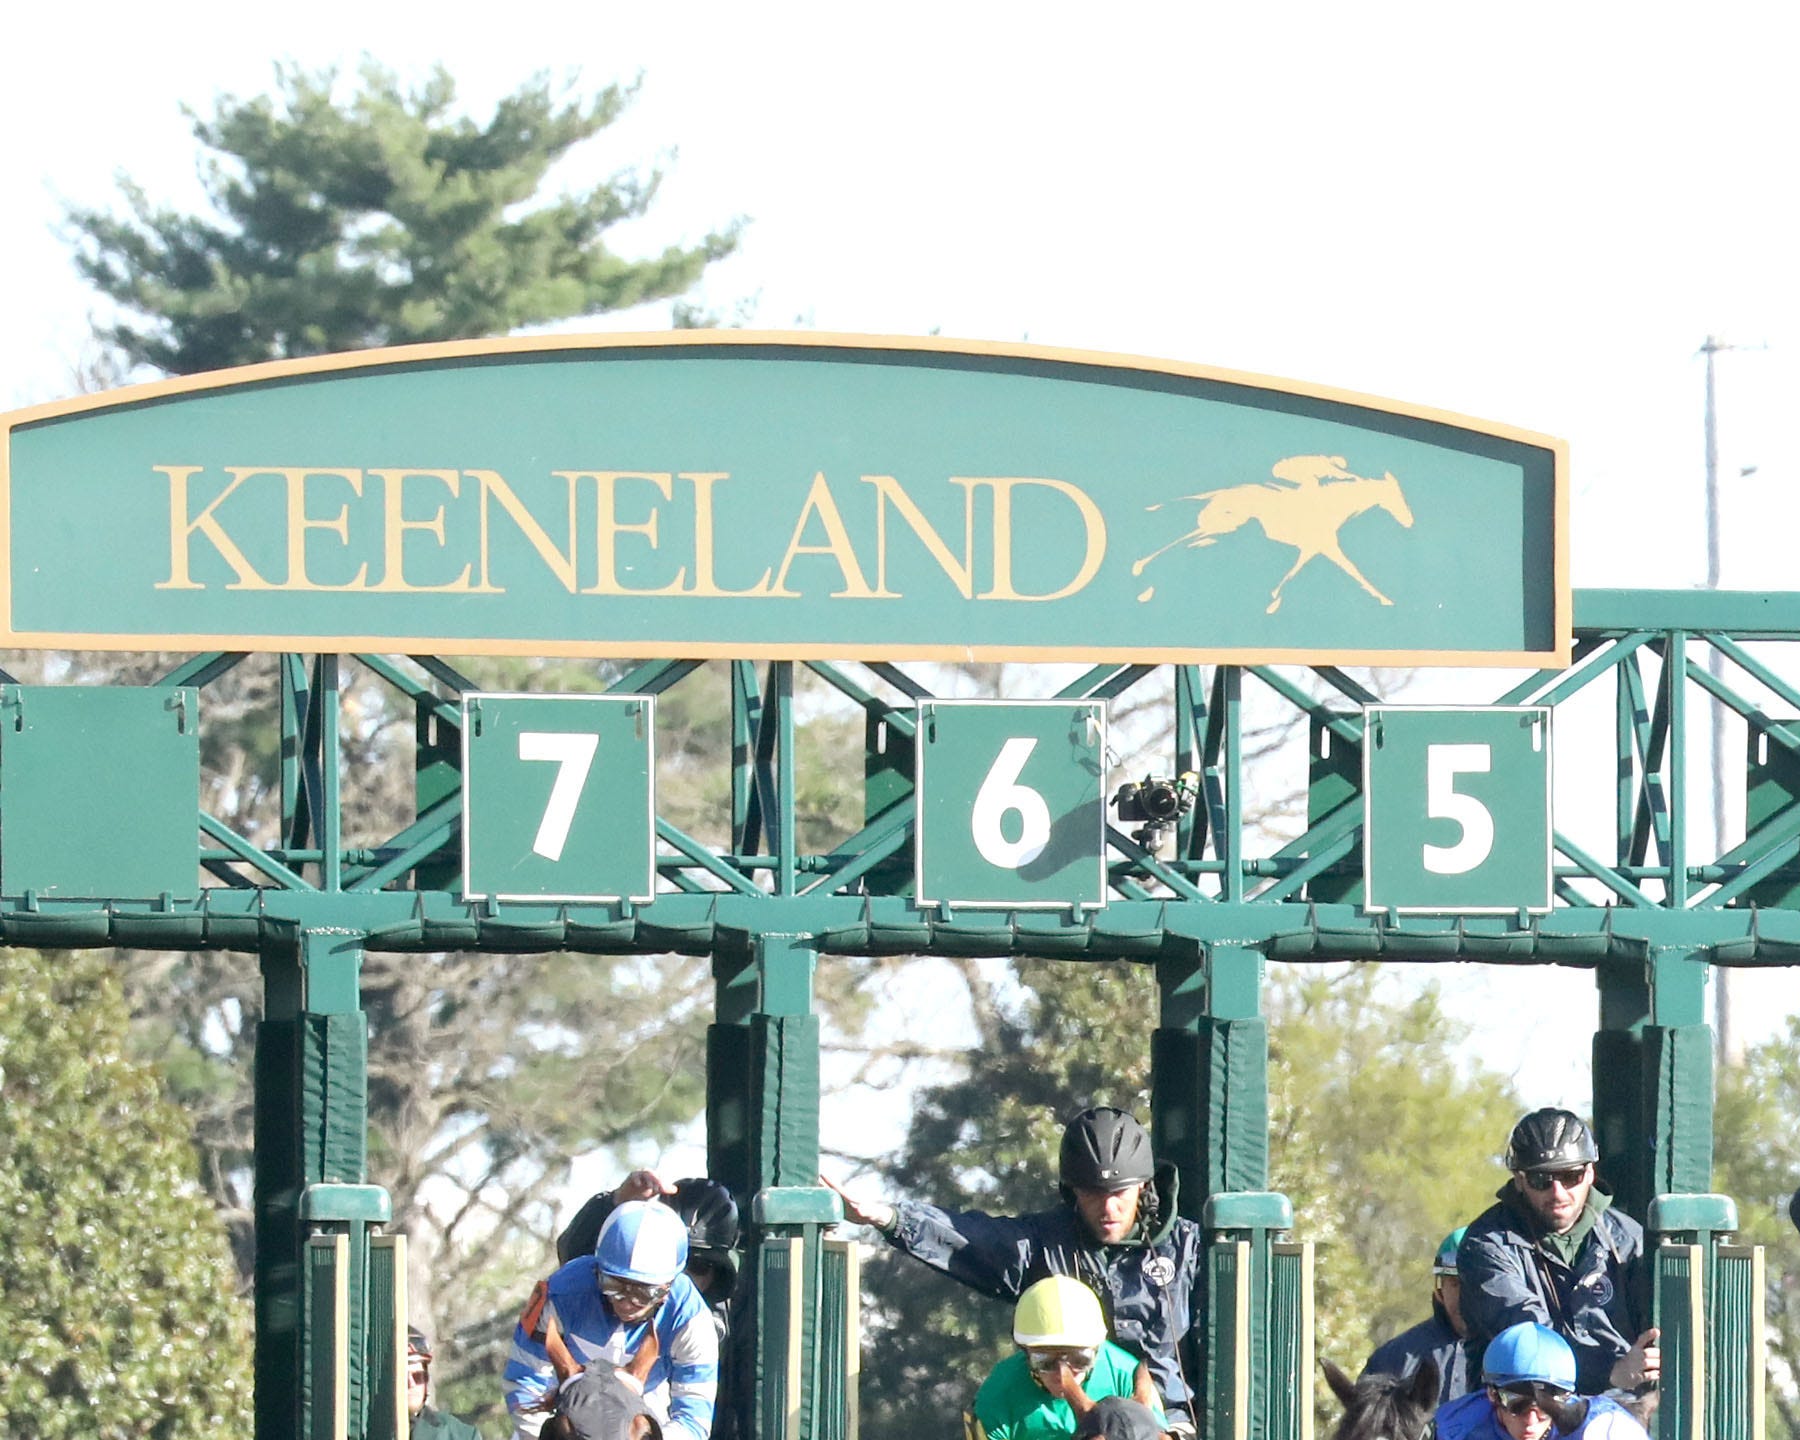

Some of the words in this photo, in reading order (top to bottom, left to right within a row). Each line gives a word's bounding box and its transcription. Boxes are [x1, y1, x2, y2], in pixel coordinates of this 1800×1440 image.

[153, 465, 1107, 602] KEENELAND
[519, 732, 599, 862] 7
[971, 737, 1051, 870] 6
[1423, 743, 1494, 874] 5
